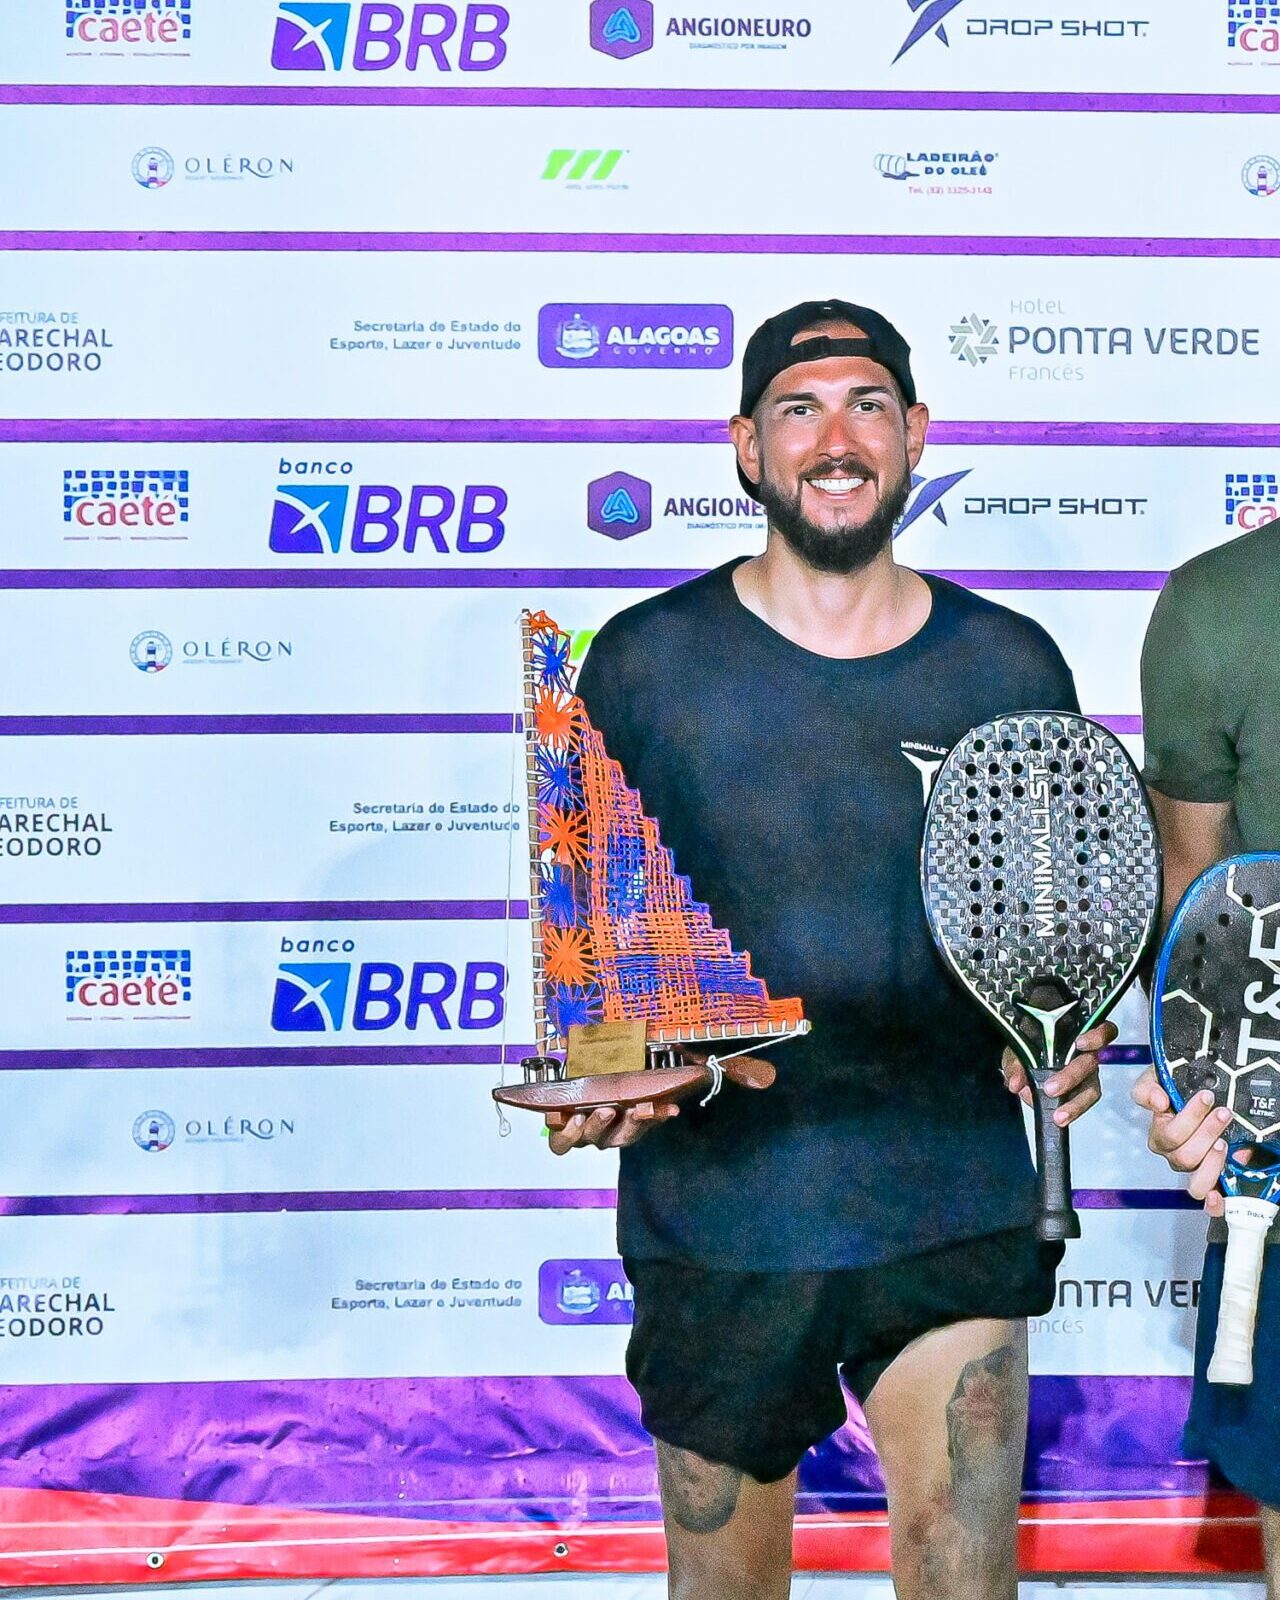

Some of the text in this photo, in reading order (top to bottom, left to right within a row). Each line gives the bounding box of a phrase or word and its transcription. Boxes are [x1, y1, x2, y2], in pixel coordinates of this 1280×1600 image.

[76, 8, 180, 46] caeté
[665, 17, 811, 38] ANGIONEURO
[966, 19, 1053, 36] DROP
[352, 3, 511, 72] BRB
[185, 158, 293, 179] OLÉRON
[924, 166, 945, 175] DO
[1010, 298, 1065, 314] Hotel
[0, 311, 79, 324] FEITURA DE
[354, 320, 425, 332] Secretaria
[450, 320, 499, 332] Estado
[0, 328, 113, 347] ARECHAL
[393, 337, 432, 350] Lazer
[447, 337, 522, 350] Juventude
[606, 324, 721, 347] ALAGOAS
[1009, 326, 1259, 355] PONTA VERDE
[612, 346, 714, 355] GOVERNO
[0, 352, 101, 371] ODORO
[278, 457, 353, 474] banco
[75, 495, 178, 527] caeté
[664, 498, 767, 516] ANGIONE
[964, 497, 1051, 514] DROP
[350, 485, 508, 554] BRB
[183, 637, 292, 662] OLÉRON
[901, 741, 949, 755] MINIMALIS
[0, 797, 78, 809] FEITURA DE
[353, 802, 424, 814] Secretaria
[450, 802, 498, 814] Estado
[0, 813, 113, 832] ARECHAL
[392, 820, 431, 832] Lazer
[0, 837, 101, 856] ODORO
[1028, 761, 1056, 938] MINIMALIST
[281, 936, 355, 953] banco
[78, 974, 180, 1008] caeté
[352, 962, 509, 1031] BRB
[1252, 1096, 1276, 1109] T&F
[186, 1116, 294, 1142] OLÉRON
[0, 1276, 80, 1289] FEITURA DE
[452, 1278, 499, 1290] Estado
[0, 1293, 115, 1312] ARECHAL
[1058, 1279, 1131, 1307] NTA
[0, 1317, 103, 1336] EODORO
